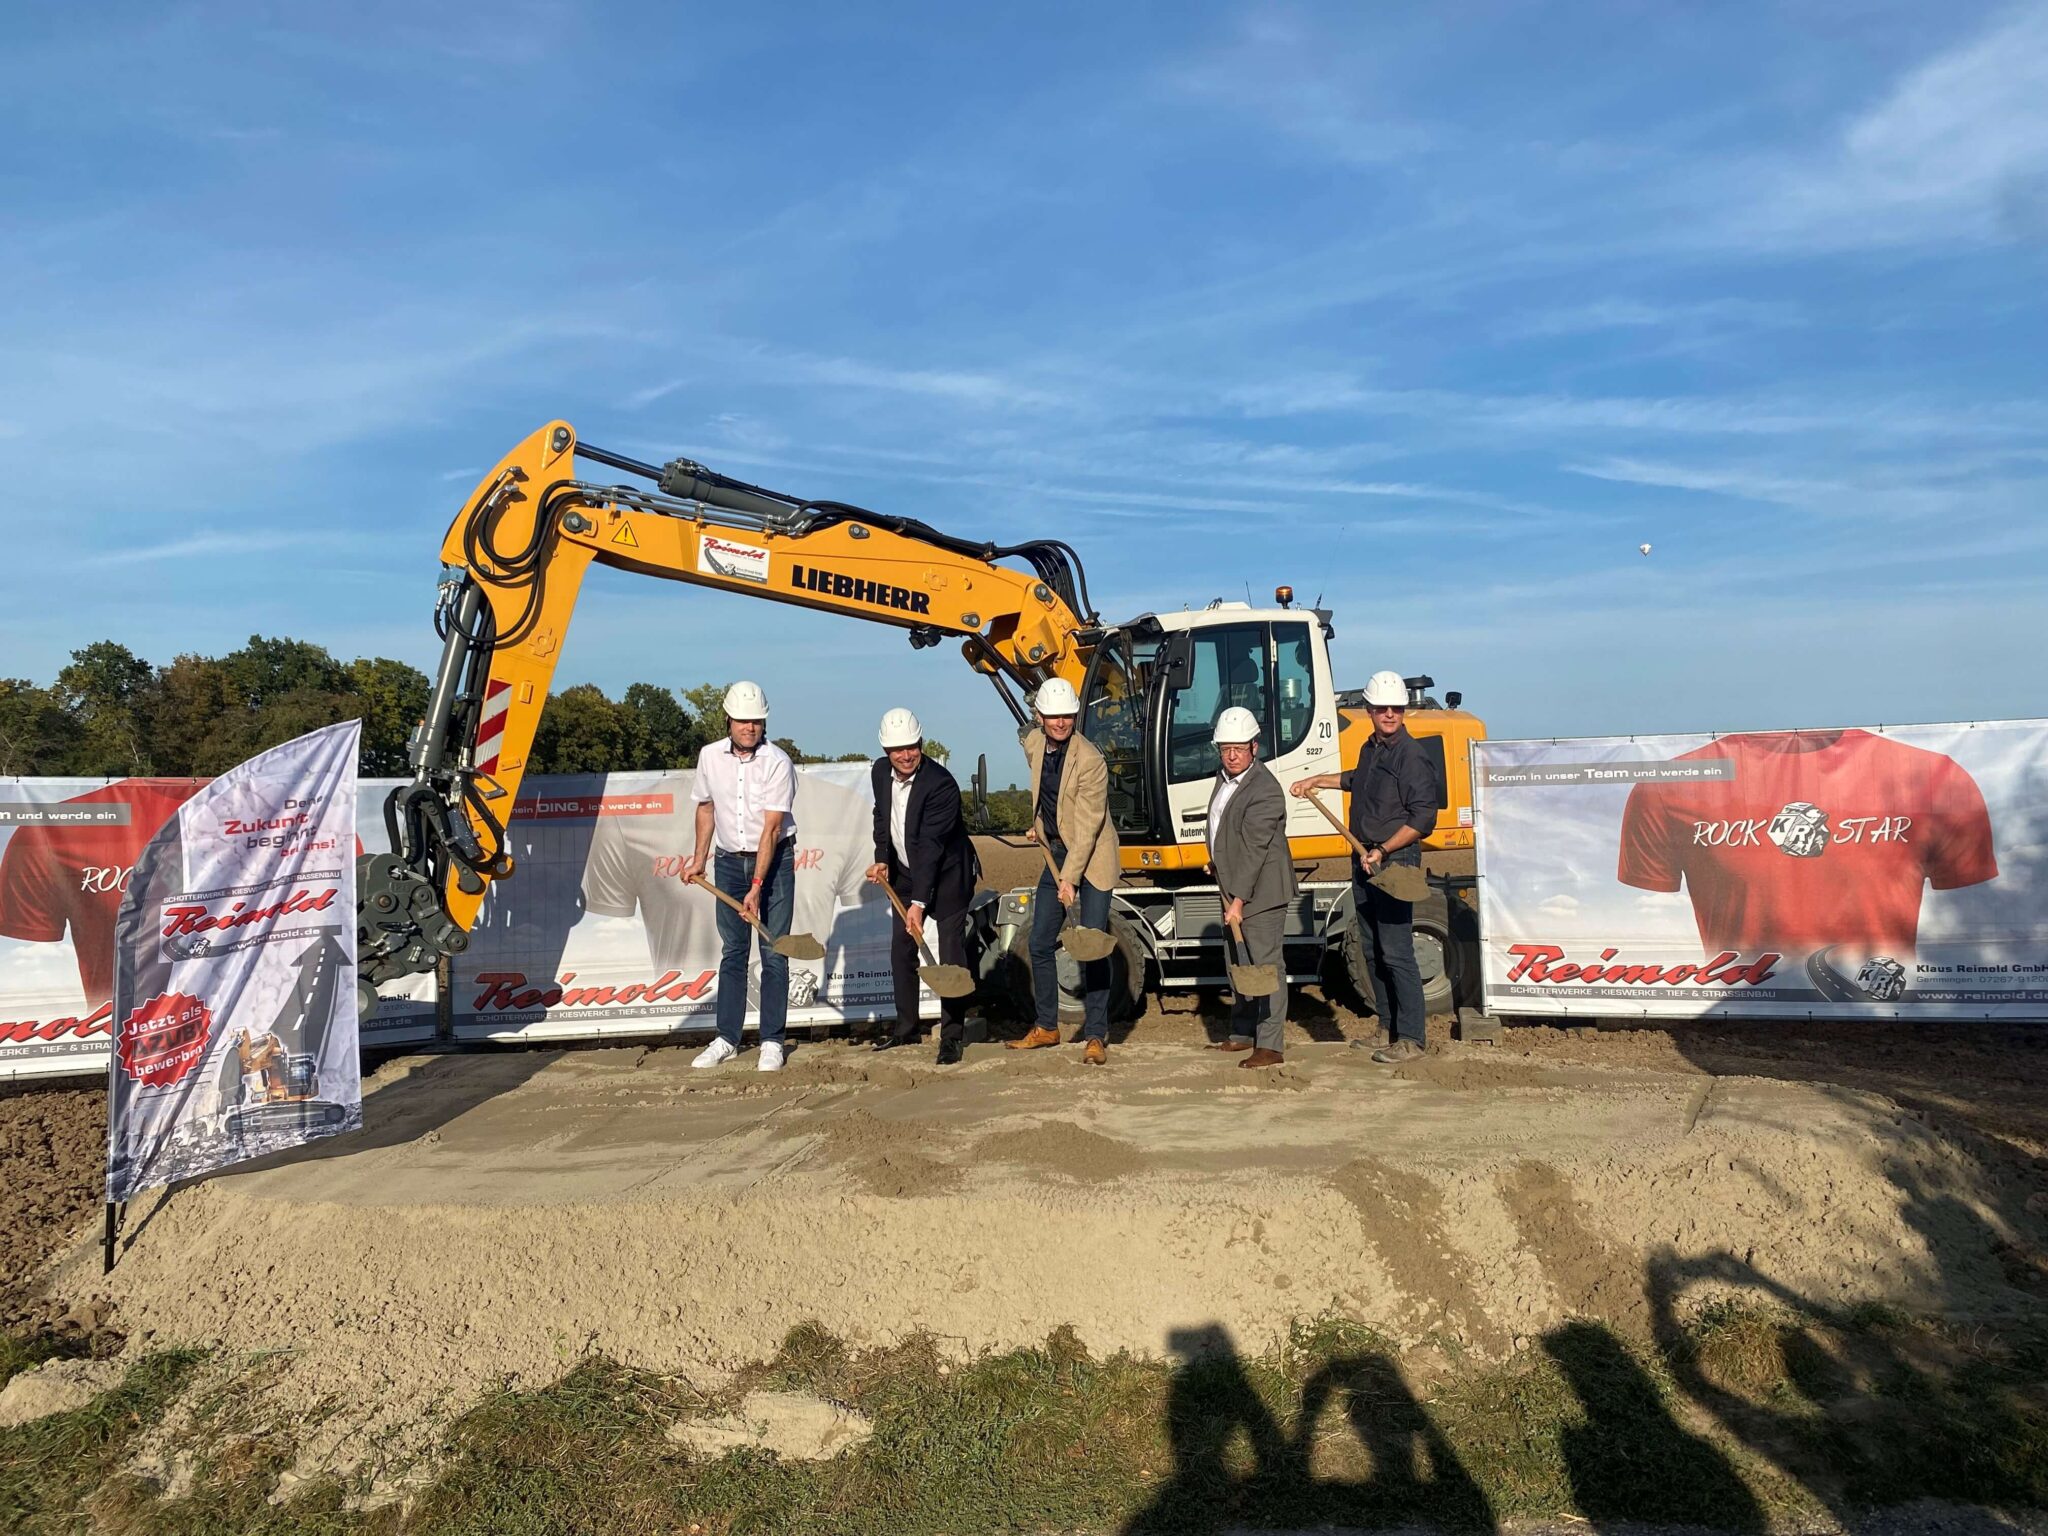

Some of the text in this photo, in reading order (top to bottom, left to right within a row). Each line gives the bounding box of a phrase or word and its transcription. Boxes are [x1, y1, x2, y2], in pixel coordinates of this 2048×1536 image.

[792, 564, 930, 615] LIEBHERR
[1319, 722, 1331, 738] 20
[1489, 774, 1526, 782] Komm
[1545, 773, 1580, 781] unser
[1584, 768, 1629, 779] Team
[1634, 768, 1656, 777] und
[1660, 767, 1699, 776] werde
[1703, 767, 1722, 776] ein
[17, 812, 43, 820] und
[48, 811, 92, 820] werde
[97, 811, 117, 820] ein
[537, 802, 584, 813] DING,
[589, 803, 604, 811] ich
[608, 802, 642, 811] werde
[224, 813, 308, 835] Zukunft
[1180, 826, 1207, 837] Autenri
[1692, 819, 1767, 847] ROCK
[1833, 815, 1912, 844] STAR
[81, 865, 134, 893] ROC
[162, 889, 338, 938] Reimold
[1507, 944, 1781, 985] Reimold
[1916, 964, 2048, 973] Klaus Reimold GmbH
[827, 972, 855, 980] Klaus
[1916, 976, 1973, 984] Gemmingen
[472, 970, 718, 1011] Reimold
[1510, 986, 1592, 996] SCHOTTERWERKE
[1601, 988, 1657, 997] KIESWERKE
[1702, 990, 1776, 999] STRASSENBAU
[129, 1006, 202, 1035] Jetzt als
[476, 1012, 551, 1022] SCHOTTERWERKE
[559, 1009, 610, 1019] KIESWERKE
[618, 1008, 638, 1016] TIEF-
[650, 1004, 713, 1014] STRASSENBAU
[41, 1046, 66, 1054] TIEF-
